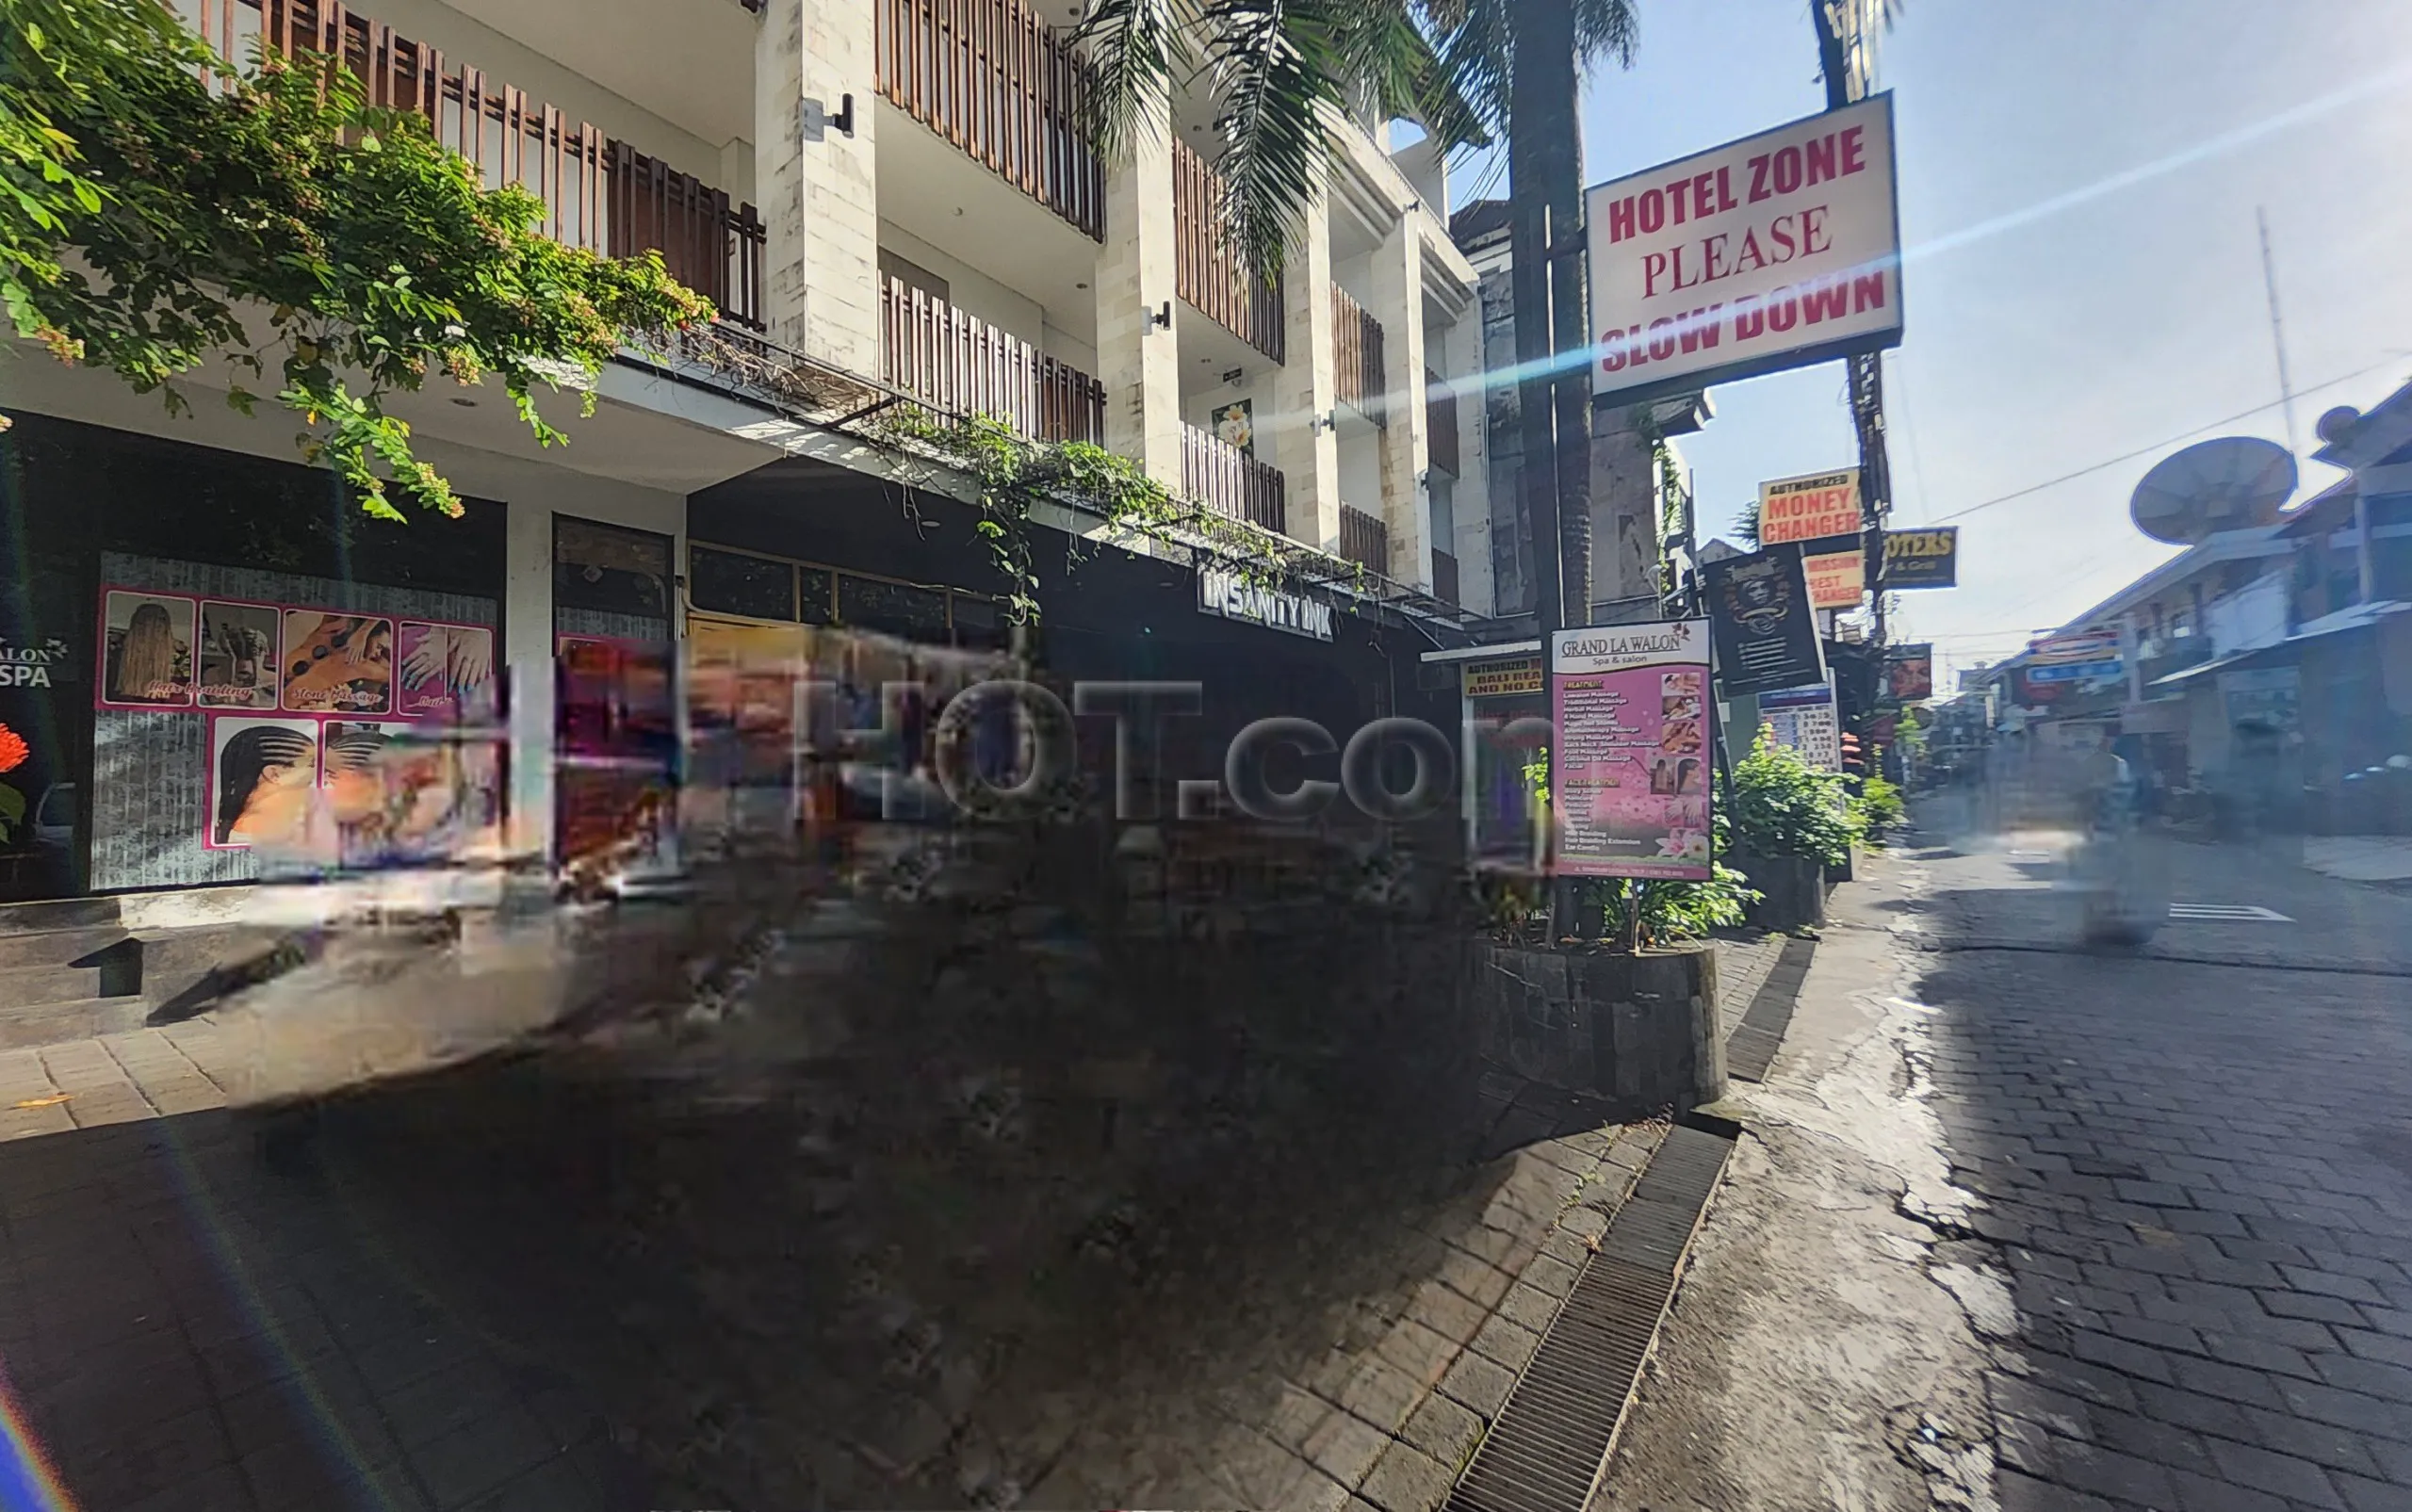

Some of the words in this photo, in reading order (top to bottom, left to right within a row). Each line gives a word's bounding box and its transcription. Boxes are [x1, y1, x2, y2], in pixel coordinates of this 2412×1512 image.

[1608, 166, 1738, 244] HOTEL
[1747, 124, 1866, 204] ZONE
[1639, 204, 1833, 301] PLEASE
[1601, 301, 1724, 372] SLOW
[1735, 269, 1884, 342] DOWN
[1768, 487, 1851, 520] MONEY
[1763, 512, 1860, 543] CHANGER
[1812, 586, 1861, 603] HANGER
[1300, 594, 1332, 639] INK
[1561, 638, 1608, 657] GRAND
[1610, 638, 1628, 652] LA
[1629, 634, 1681, 652] WALON
[1468, 660, 1528, 674] AUTHORIZED
[1592, 658, 1609, 666] Spa
[1622, 656, 1648, 664] salon
[0, 664, 51, 688] SPA
[1476, 674, 1509, 685] BALI
[1562, 680, 1604, 690] TREATMENT
[186, 683, 253, 698] Braiding
[1468, 685, 1499, 694] AND
[1503, 683, 1524, 692] NO
